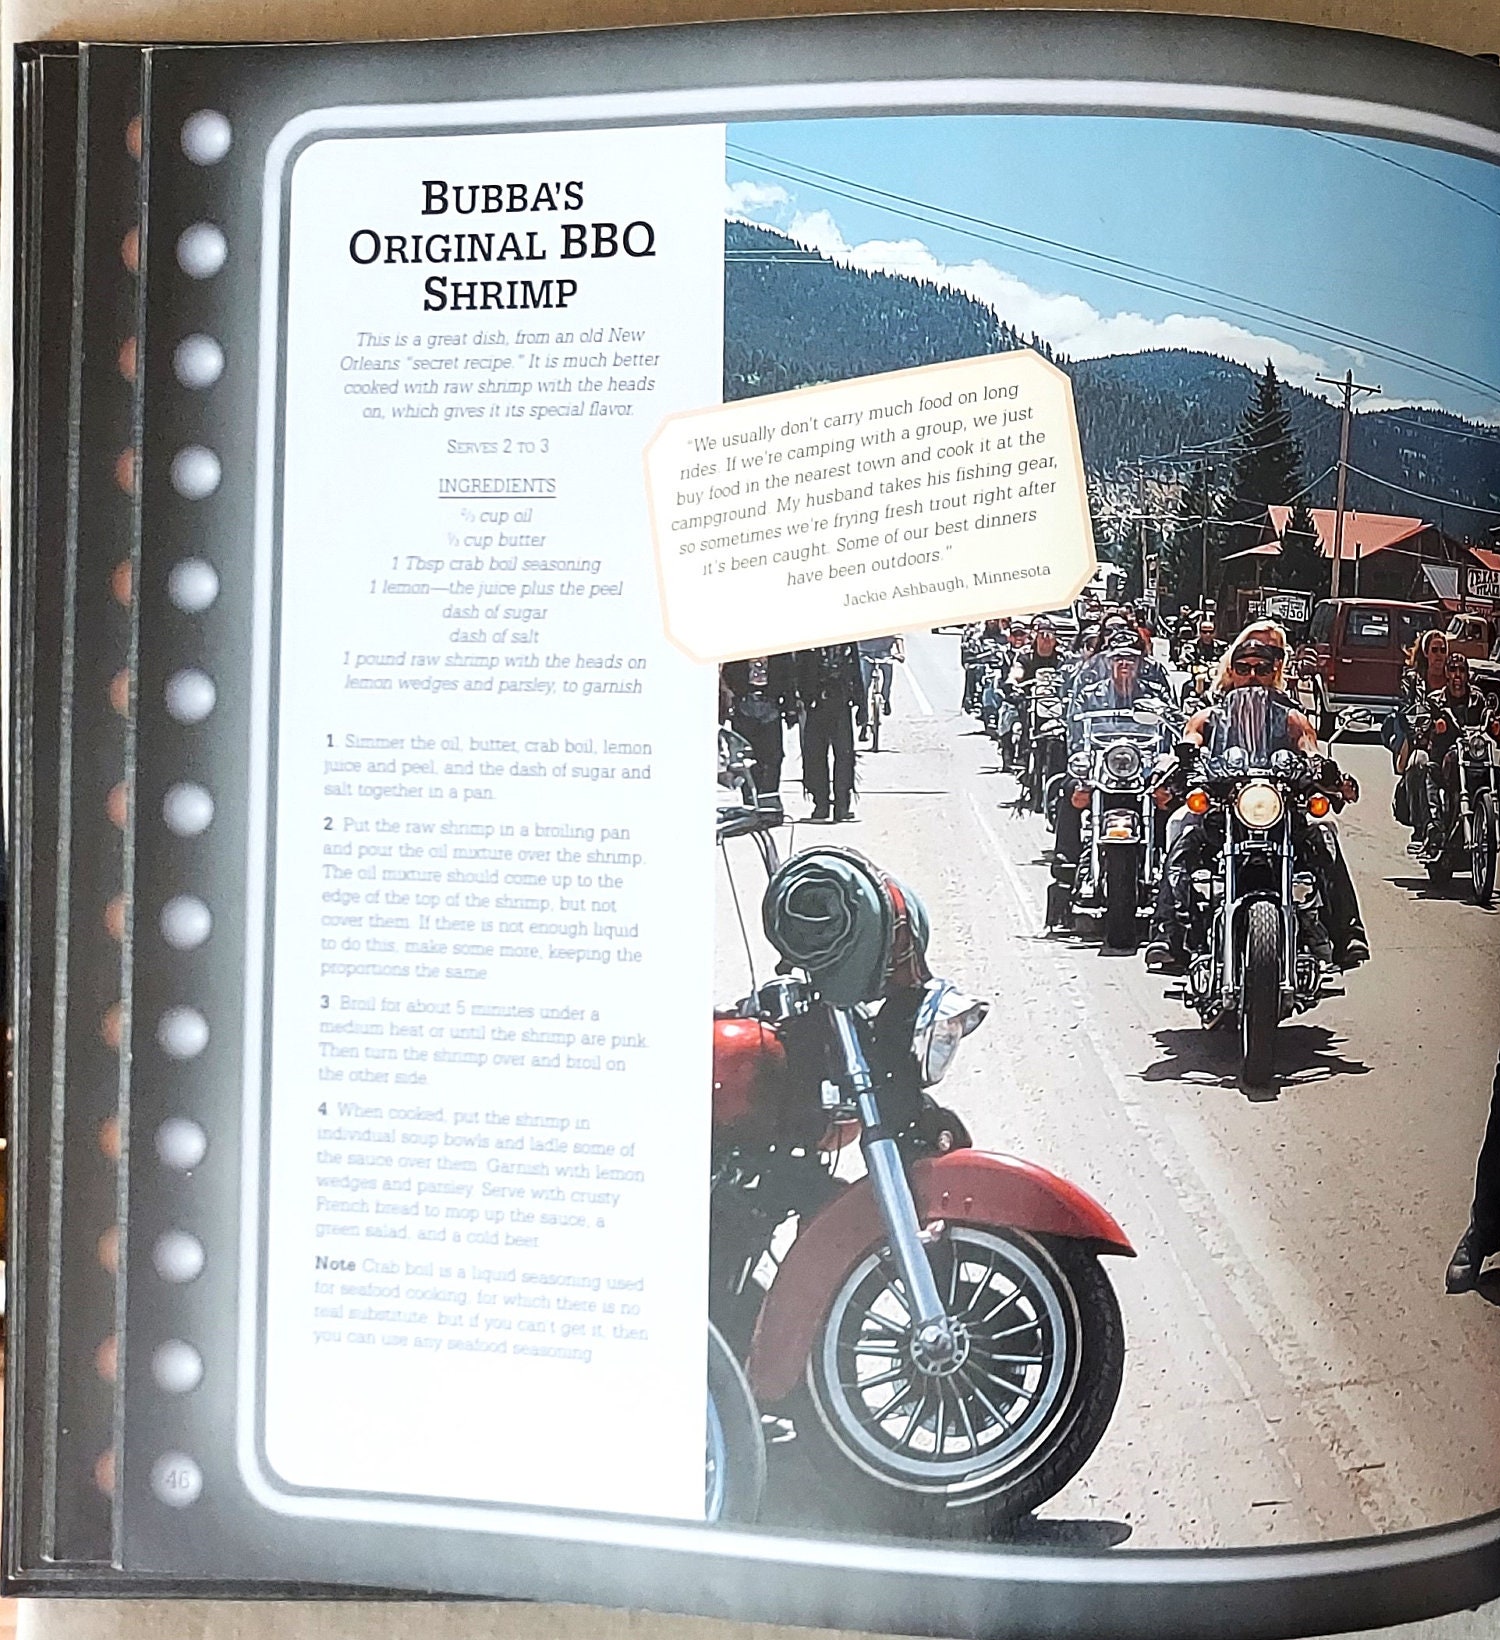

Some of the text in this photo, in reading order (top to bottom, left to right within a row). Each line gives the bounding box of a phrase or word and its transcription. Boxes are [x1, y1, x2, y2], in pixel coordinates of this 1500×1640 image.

[349, 220, 656, 266] ORIGINAL BBQ
[423, 275, 578, 312] SHRIMP
[357, 332, 391, 348] This
[394, 334, 409, 347] is
[412, 335, 422, 347] a
[426, 333, 468, 349] great
[514, 329, 550, 345] from
[555, 332, 575, 344] an
[579, 327, 604, 343] old
[608, 326, 646, 343] New
[343, 375, 656, 397] cooked with raw shrimp with the heads
[722, 424, 776, 448] usually
[780, 416, 819, 437] don't
[823, 410, 864, 429] carry
[868, 399, 913, 421] much
[919, 391, 953, 412] food
[957, 391, 978, 405] on
[983, 384, 1019, 401] long
[447, 437, 549, 454] SERVES 2 TO 3
[676, 430, 1046, 506] buy food in the nearest town and cook it at the
[439, 477, 556, 494] INGREDIENTS
[678, 480, 1057, 555] so sometimes we're frying fresh trout right after
[392, 555, 602, 574] 1 Tbsp crab boil seasoning
[843, 589, 888, 607] Jackie
[972, 565, 1051, 587] Minnesota
[1469, 570, 1499, 587] TEXAS
[344, 674, 393, 690] lemon
[398, 675, 460, 694] wedges
[463, 676, 495, 692] and
[562, 679, 579, 693] to
[582, 677, 643, 697] garnish
[166, 1468, 190, 1489] 46
